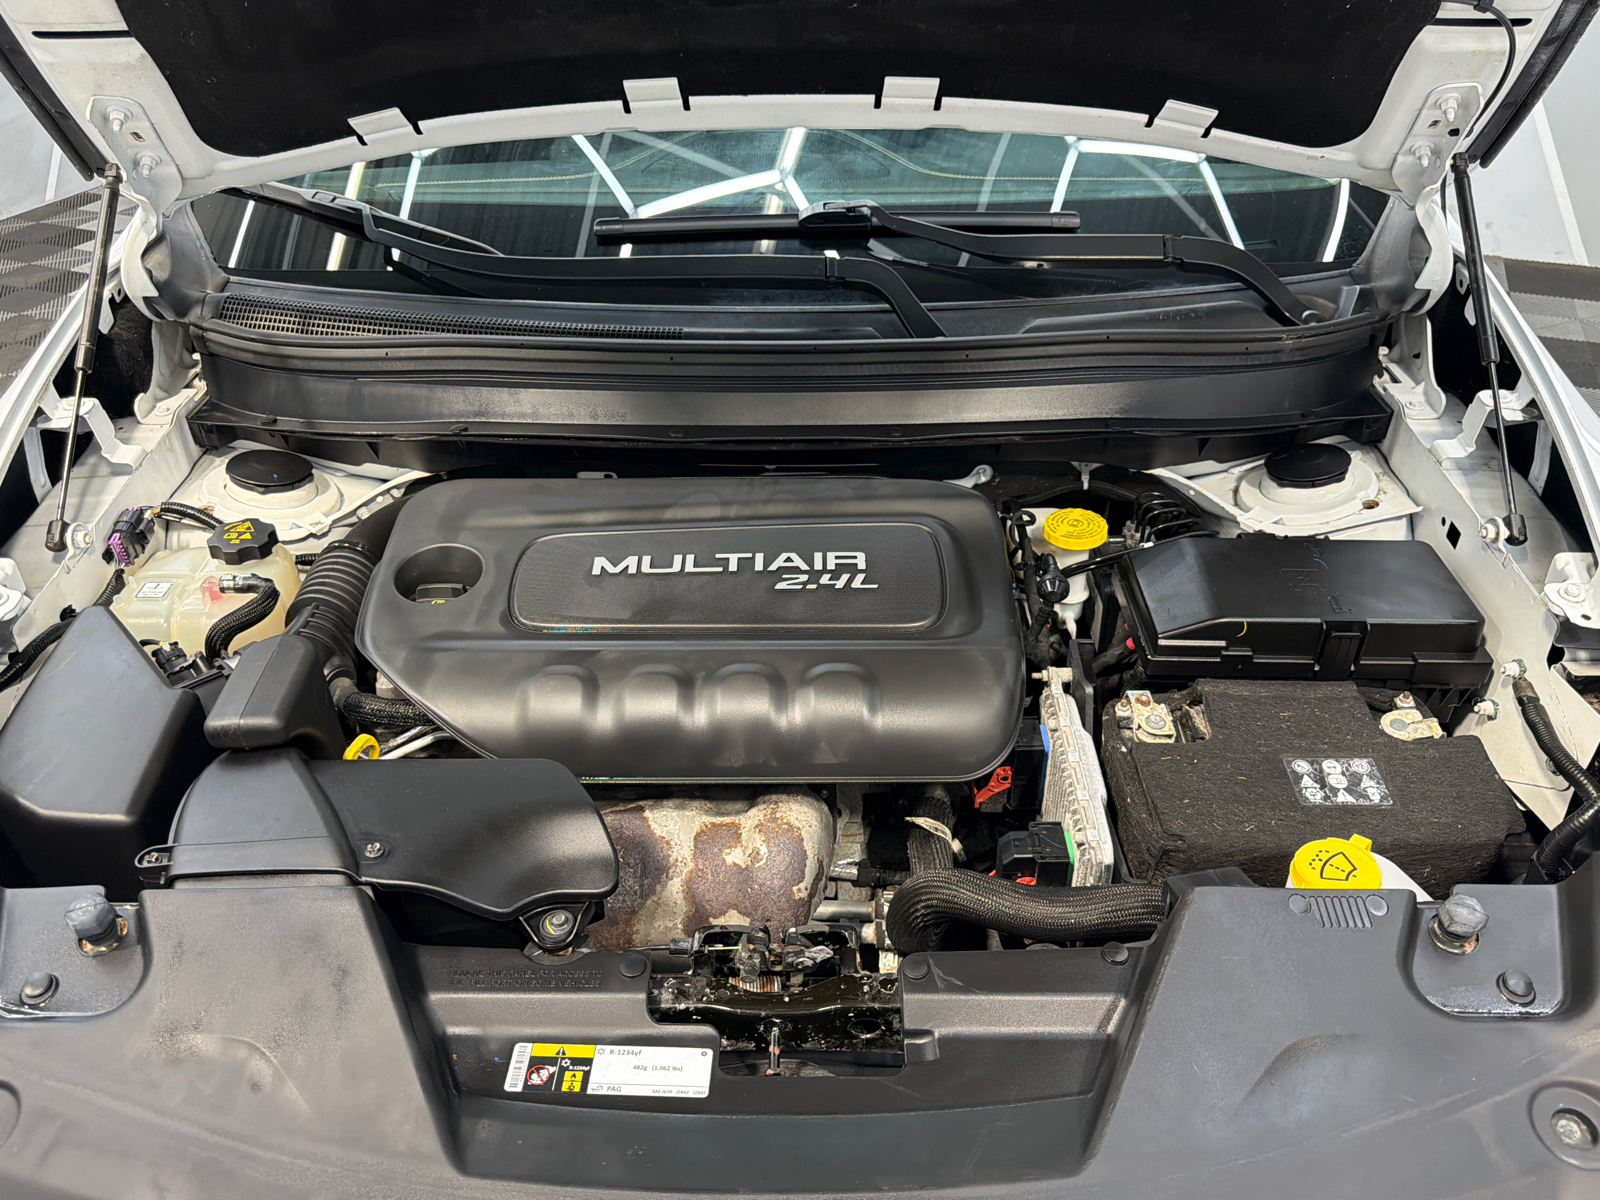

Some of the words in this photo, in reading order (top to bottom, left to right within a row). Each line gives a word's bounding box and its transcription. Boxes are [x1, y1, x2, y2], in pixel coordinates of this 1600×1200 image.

[591, 552, 867, 575] MULTIAIR
[774, 573, 879, 590] 2.4L
[538, 970, 554, 978] FOR
[558, 970, 590, 978] ACCESS
[559, 979, 601, 987] VEHICLES
[609, 1049, 642, 1057] R-1234yf
